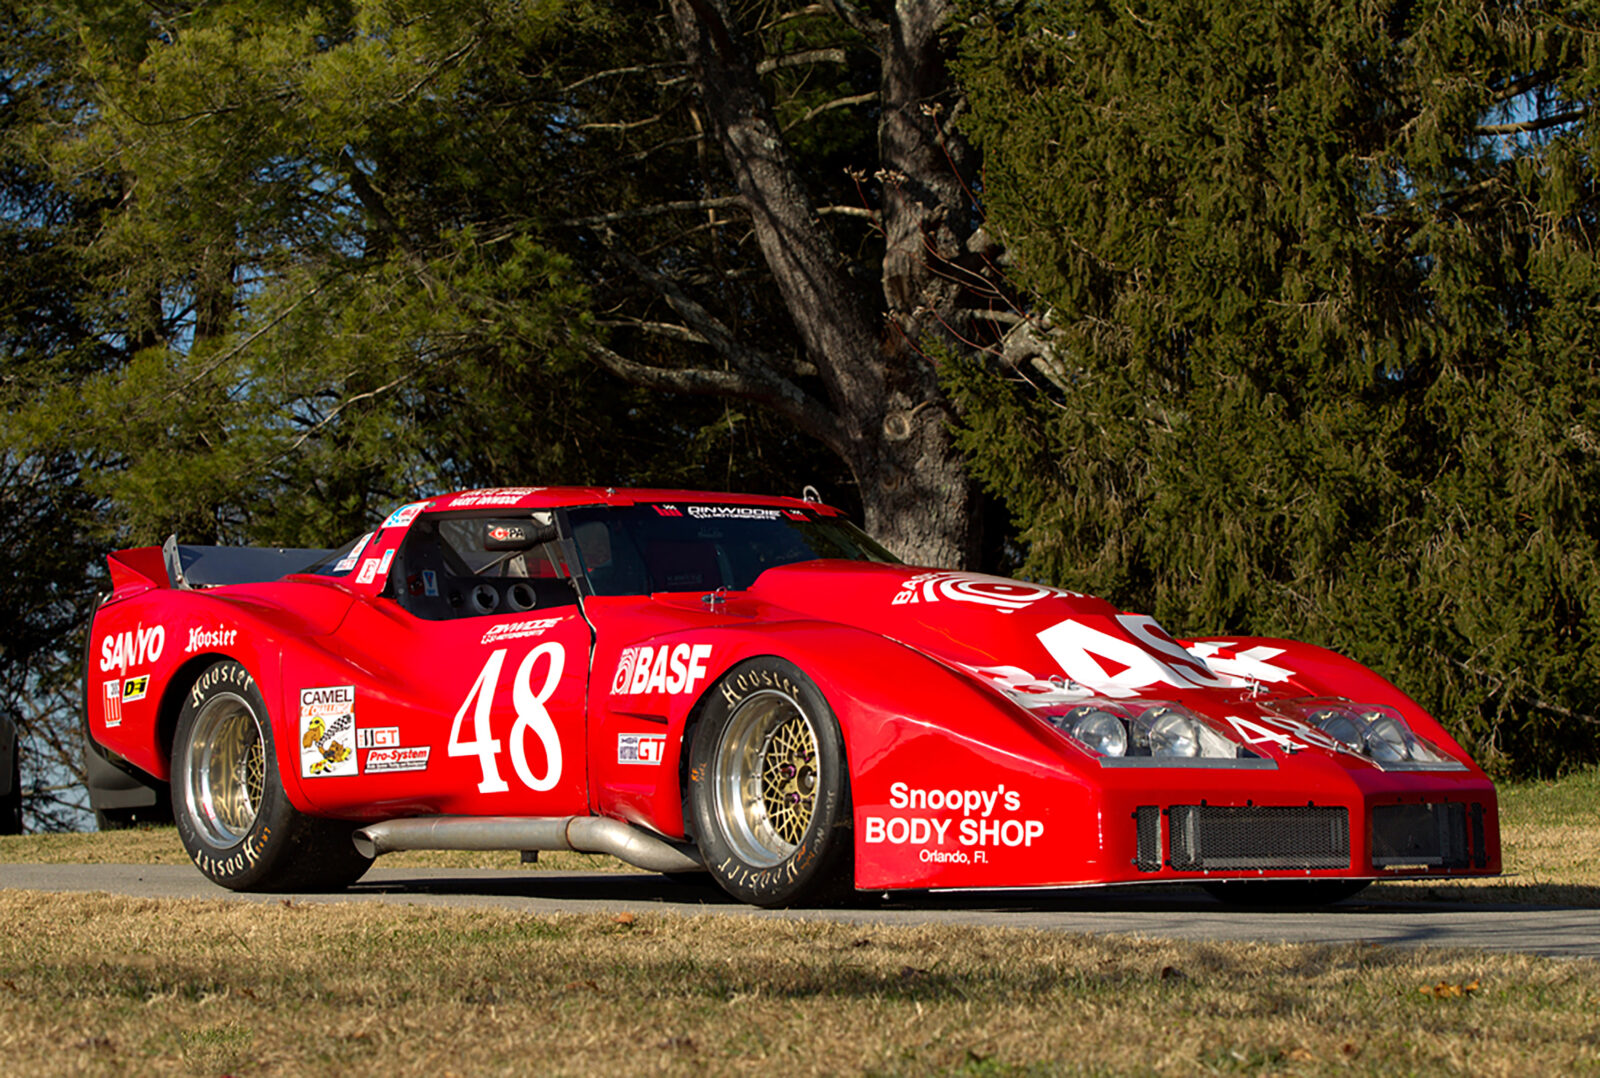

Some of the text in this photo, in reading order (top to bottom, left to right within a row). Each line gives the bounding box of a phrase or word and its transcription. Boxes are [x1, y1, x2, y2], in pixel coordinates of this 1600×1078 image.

[100, 622, 165, 676] SANYO
[185, 624, 237, 653] Hoosier
[630, 643, 713, 695] BASF
[192, 665, 254, 708] Hoosier
[302, 688, 353, 706] CAMEL
[719, 669, 801, 711] Hoosier
[447, 641, 566, 794] 48
[1223, 715, 1346, 753] 48
[374, 729, 398, 745] GT
[638, 738, 667, 762] GT
[369, 748, 428, 763] Pro-System
[889, 781, 1021, 817] Snoopy's
[865, 817, 1044, 847] BODY SHOP
[194, 835, 260, 877] Hoosier
[717, 856, 798, 889] Hoosier
[919, 848, 989, 865] Orlando, Fl.
